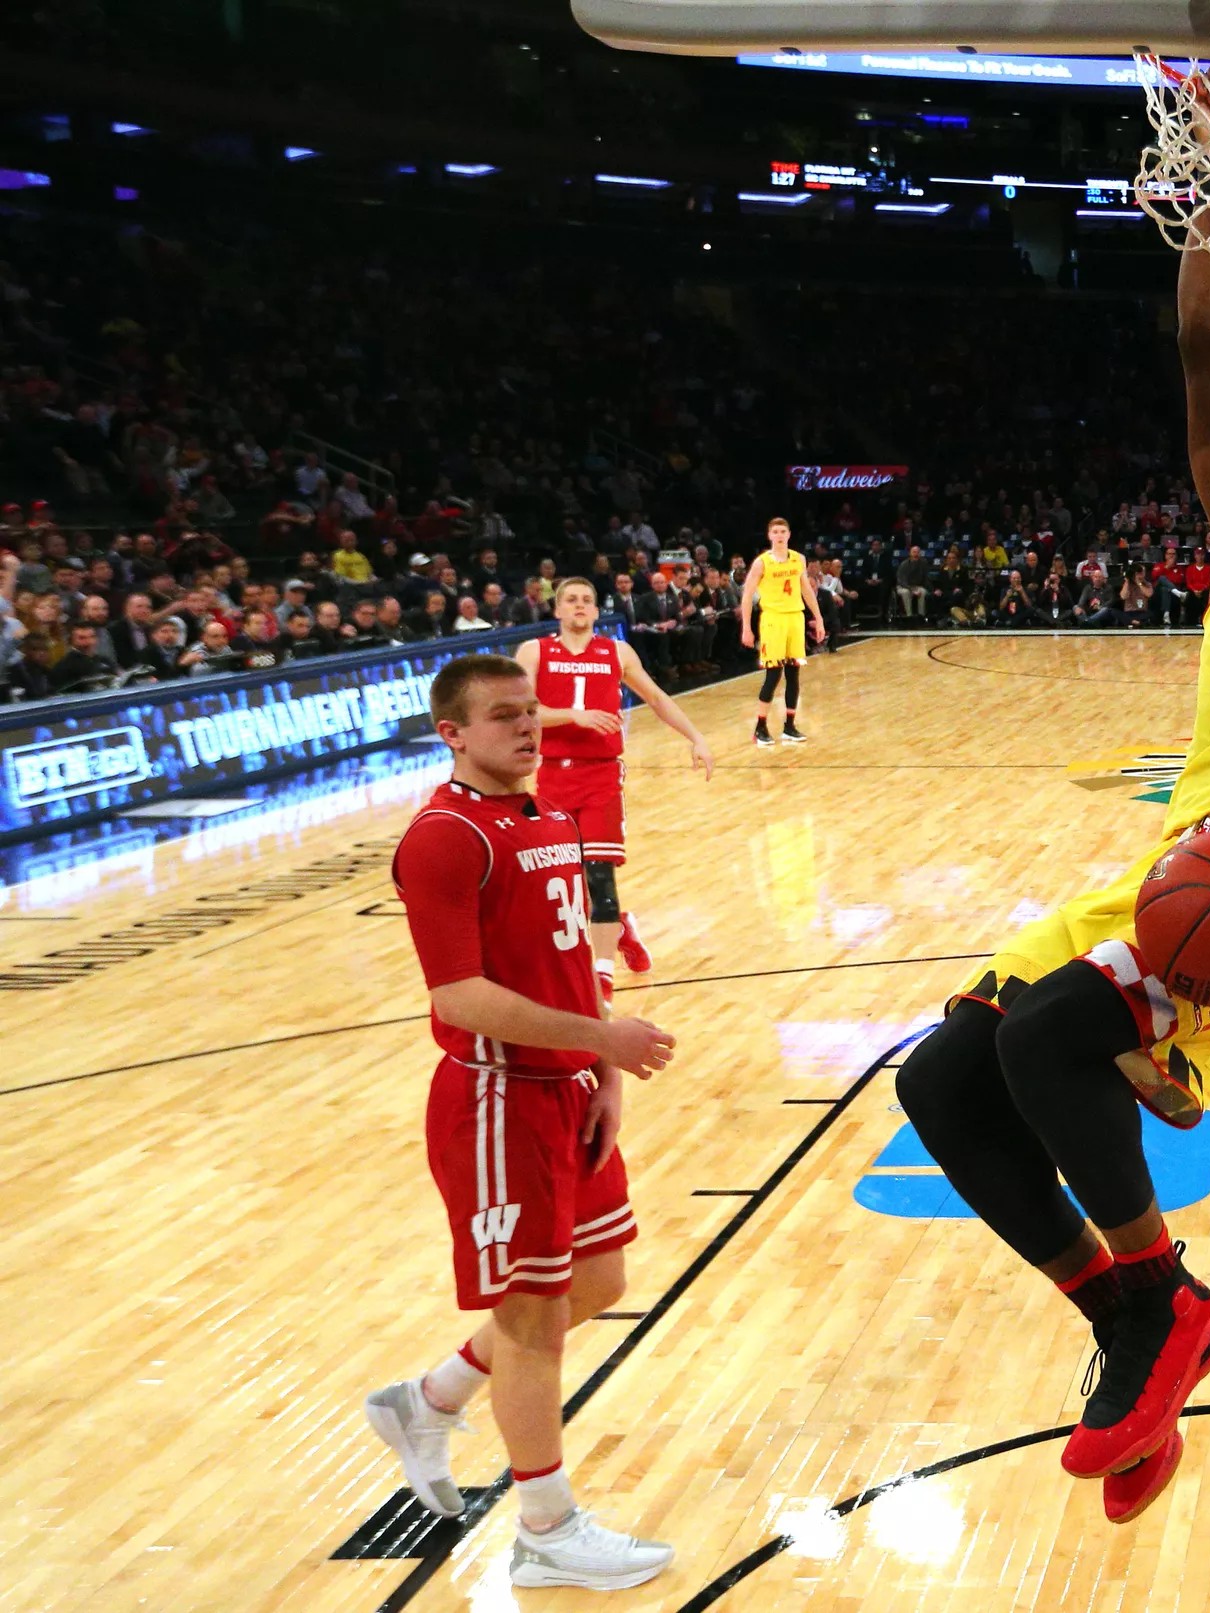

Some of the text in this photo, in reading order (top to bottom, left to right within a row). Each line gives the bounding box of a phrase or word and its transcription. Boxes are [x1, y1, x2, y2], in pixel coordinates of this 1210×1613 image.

[771, 161, 800, 174] TIME
[783, 579, 792, 597] 4
[548, 661, 611, 675] WISCONSIN
[573, 675, 586, 711] 1
[170, 687, 365, 769] TOURNAMENT
[546, 873, 591, 951] 34
[471, 1203, 522, 1252] W
